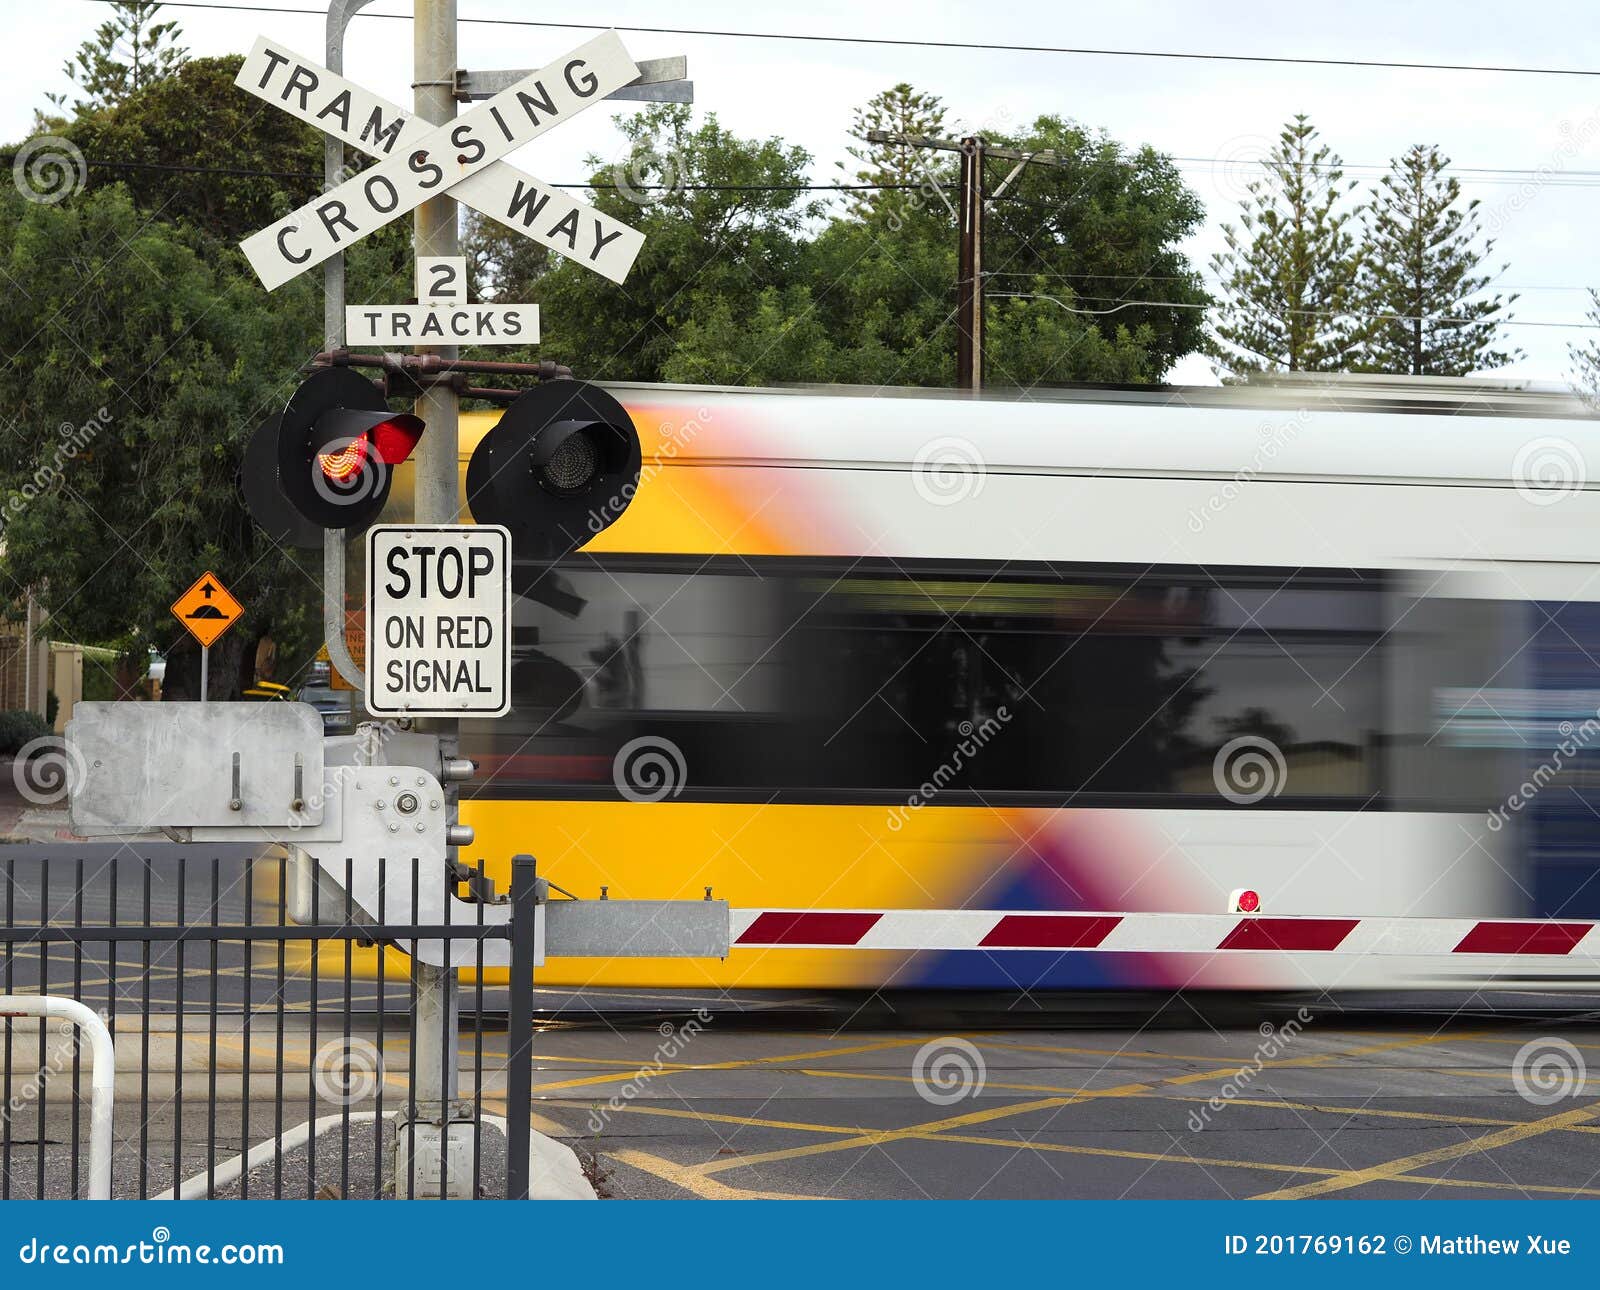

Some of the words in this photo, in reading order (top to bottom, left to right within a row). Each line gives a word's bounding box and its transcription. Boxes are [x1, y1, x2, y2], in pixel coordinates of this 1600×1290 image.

[258, 49, 406, 154] TRAM
[506, 180, 622, 261] WAY
[277, 59, 599, 264] CROSSING
[429, 264, 457, 297] 2
[363, 311, 522, 337] TRACKS
[385, 546, 494, 599] STOP
[385, 615, 424, 649] ON
[437, 615, 493, 649] RED
[385, 659, 492, 693] SIGNAL
